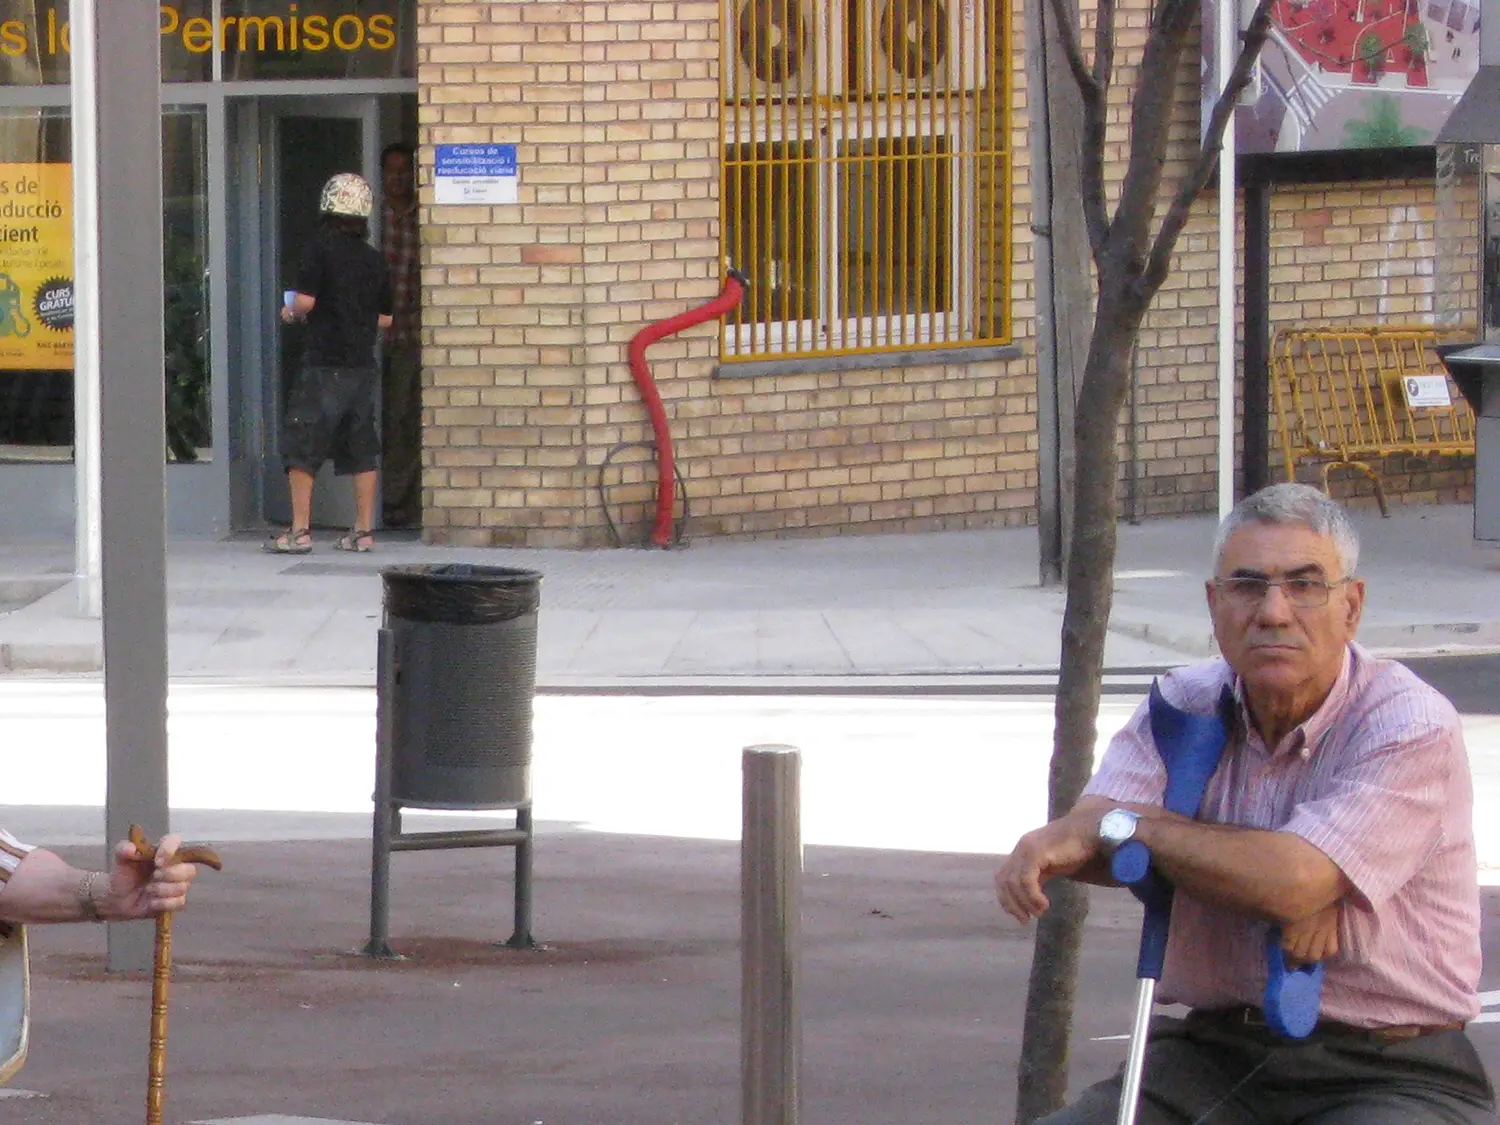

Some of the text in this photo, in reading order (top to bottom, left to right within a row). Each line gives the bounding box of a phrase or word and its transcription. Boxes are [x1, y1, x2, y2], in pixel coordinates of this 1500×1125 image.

[160, 4, 396, 52] Permisos
[16, 176, 38, 194] de
[45, 287, 71, 301] CURS
[39, 296, 74, 311] GRATU
